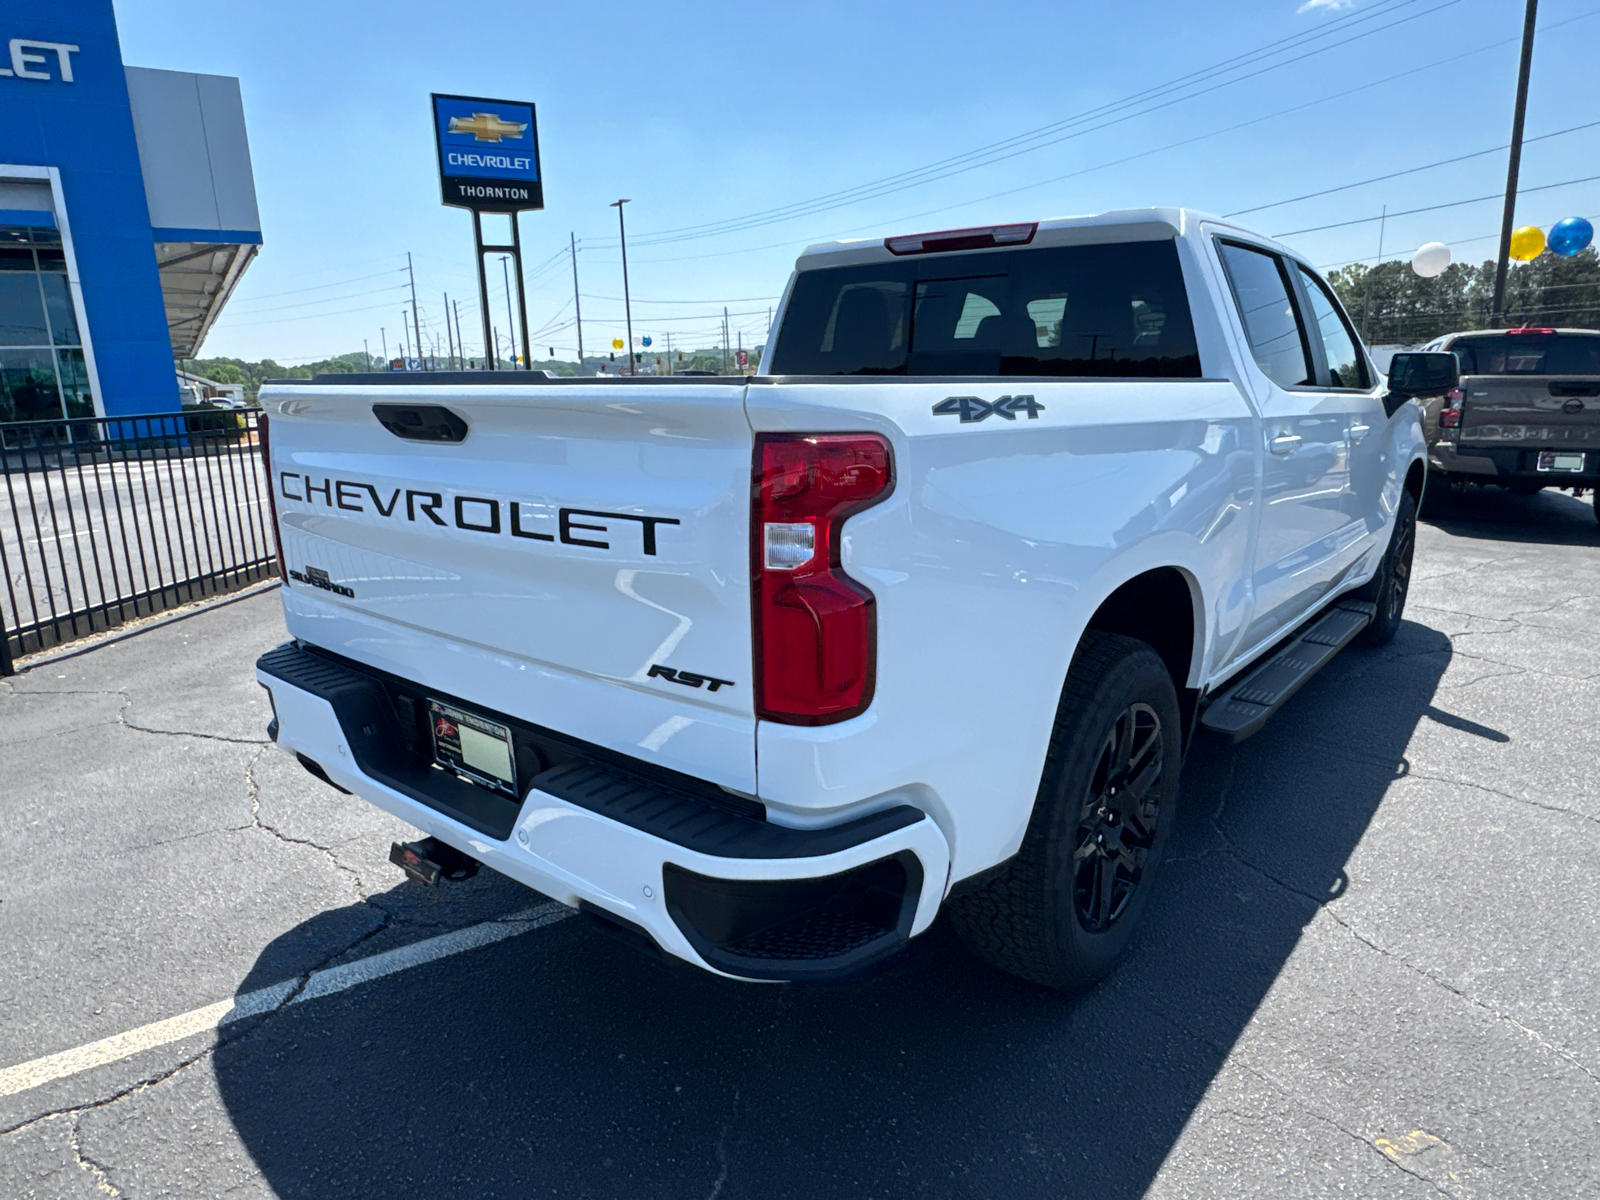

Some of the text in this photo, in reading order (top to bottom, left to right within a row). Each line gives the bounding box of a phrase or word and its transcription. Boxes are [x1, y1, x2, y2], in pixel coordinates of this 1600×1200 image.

[448, 152, 531, 170] CHEVROLET
[458, 185, 529, 199] THORNTON
[281, 472, 680, 555] CHEVROLET
[646, 664, 736, 692] RST
